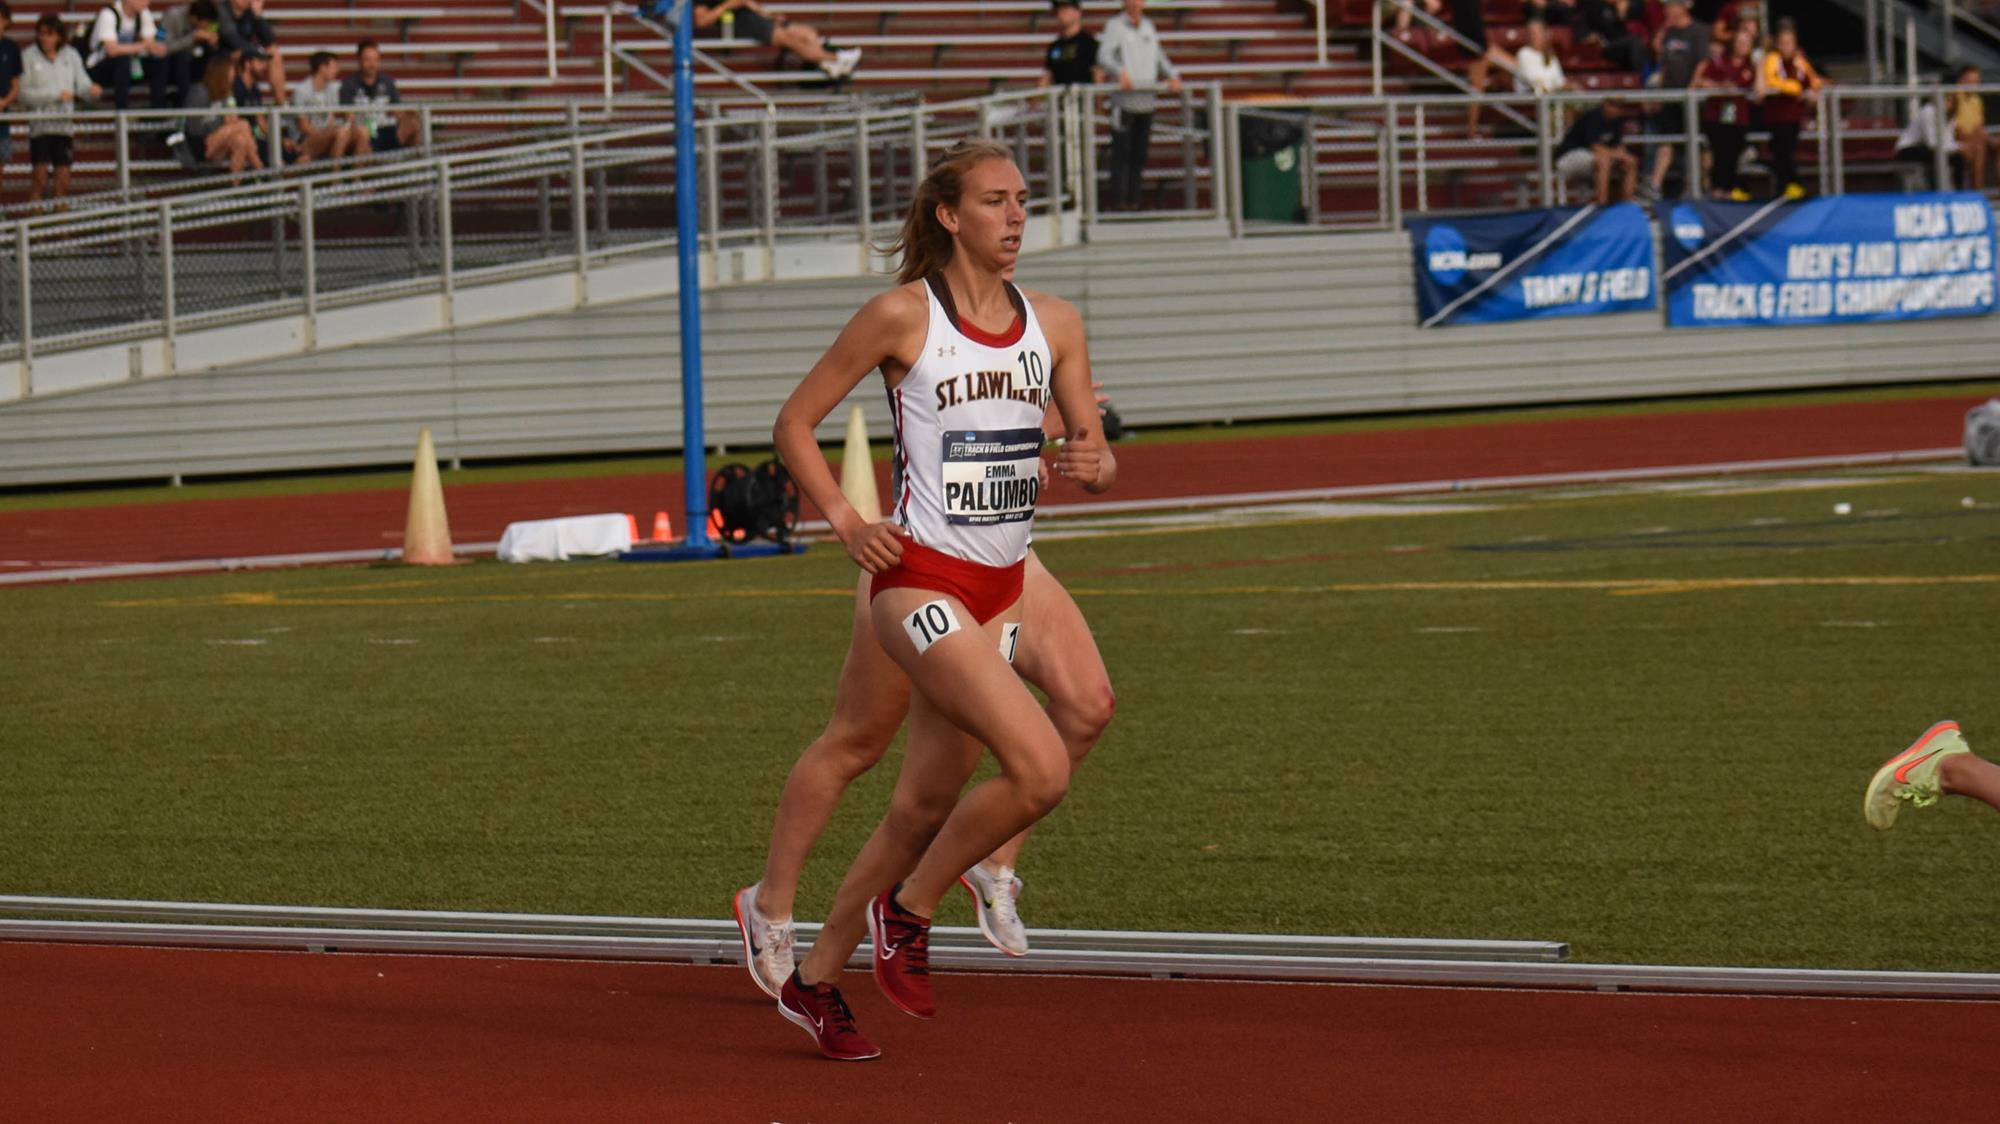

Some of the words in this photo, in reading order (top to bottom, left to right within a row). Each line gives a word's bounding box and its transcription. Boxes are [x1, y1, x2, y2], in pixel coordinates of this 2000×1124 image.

[1787, 242, 1852, 280] MEN'S
[1854, 241, 1896, 277] AND
[1899, 235, 1992, 277] WOMEN'S
[1521, 271, 1584, 309] TRACK
[1599, 267, 1649, 303] FIELD
[1693, 283, 1757, 319] TRACK
[1778, 281, 1832, 317] FIELD
[1835, 271, 1994, 316] CHAMPIONSHIPS
[1017, 351, 1043, 386] 10
[935, 375, 964, 411] ST.
[986, 464, 1016, 478] EMMA
[945, 477, 1039, 511] PALUMBO
[912, 604, 949, 644] 10
[1009, 625, 1018, 661] 1
